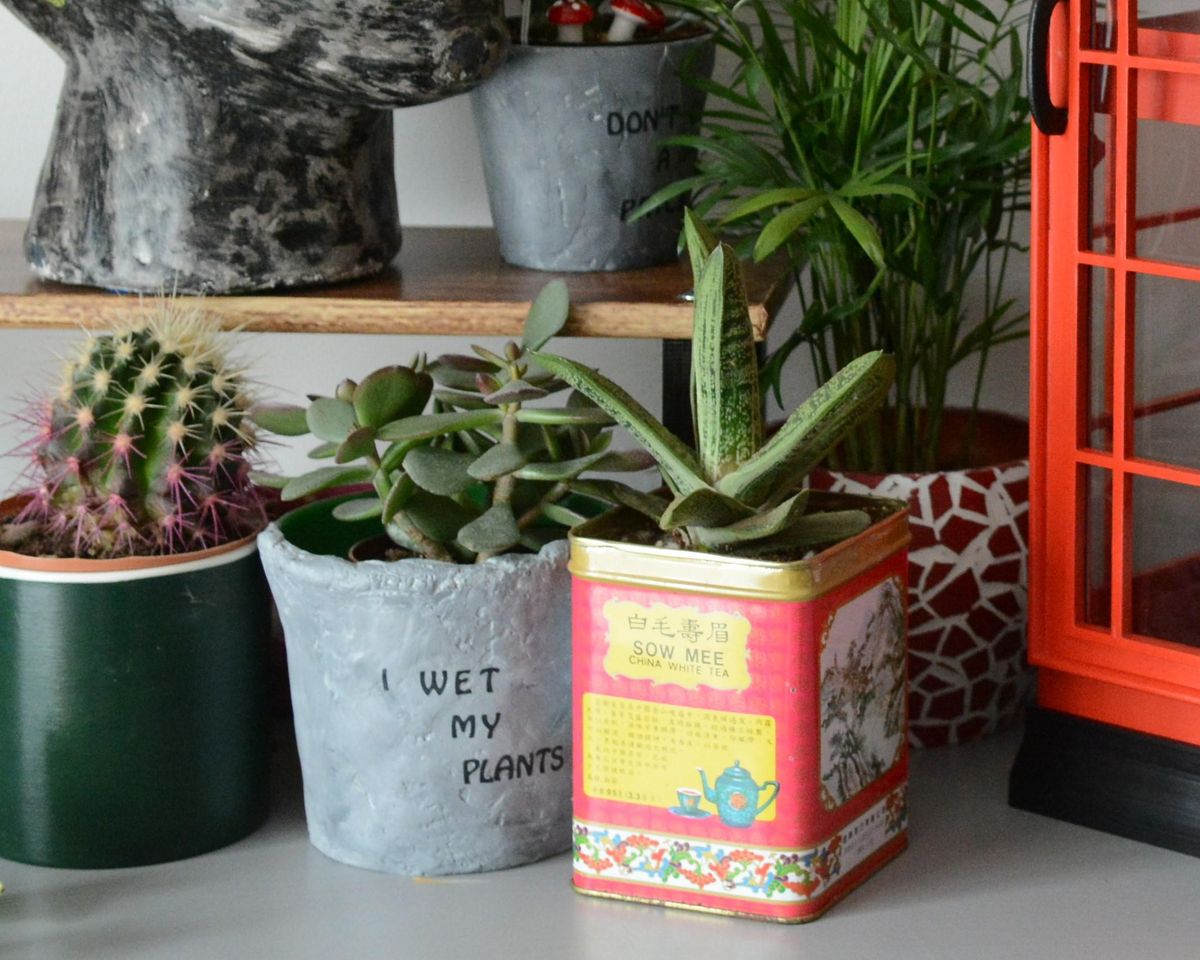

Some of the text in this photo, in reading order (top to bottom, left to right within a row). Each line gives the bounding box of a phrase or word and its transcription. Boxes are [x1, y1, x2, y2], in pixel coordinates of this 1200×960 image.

[628, 655, 730, 679] CHINA WHITE TEA
[633, 640, 725, 667] SOW MEE
[382, 667, 500, 696] I WET
[451, 712, 501, 739] MY
[462, 745, 565, 785] PLANTS
